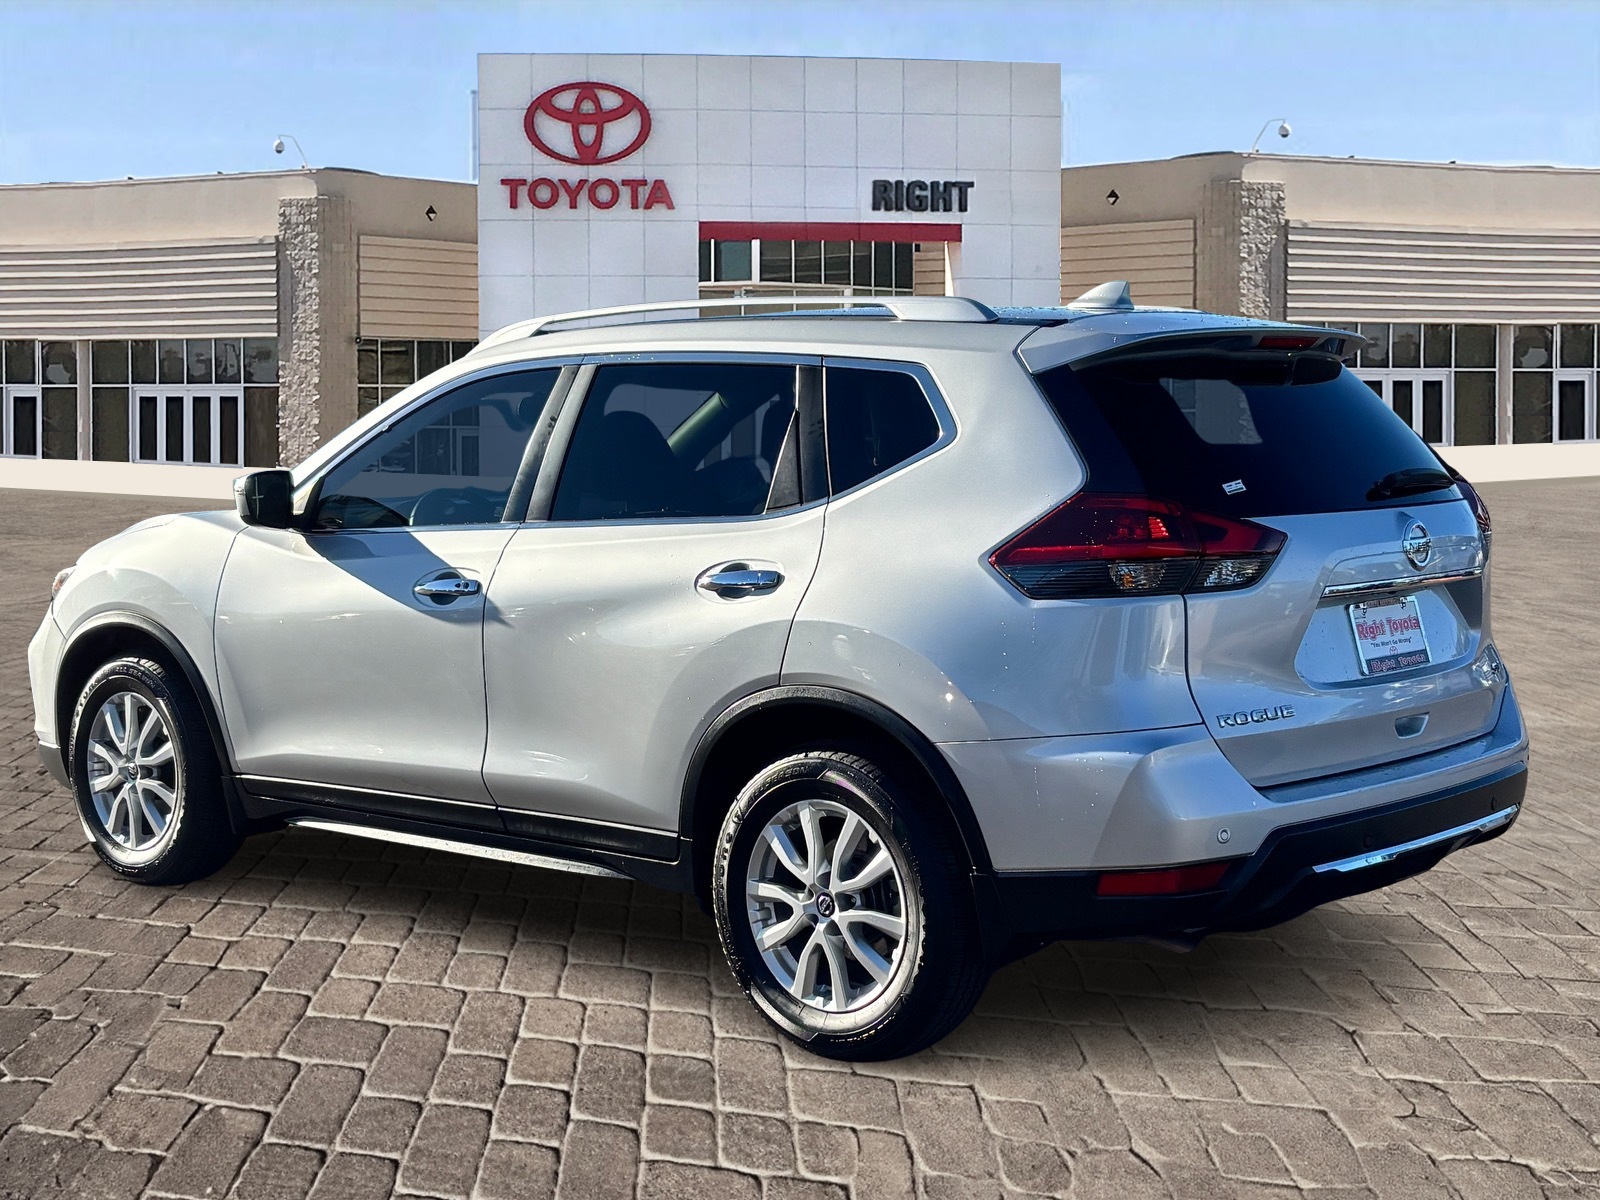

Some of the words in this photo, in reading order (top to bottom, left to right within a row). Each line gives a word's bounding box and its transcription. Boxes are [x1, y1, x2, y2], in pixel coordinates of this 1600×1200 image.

[500, 178, 675, 209] TOYOTA
[872, 179, 975, 212] RIGHT
[1355, 619, 1386, 641] Right
[1386, 614, 1421, 636] Toyota
[1216, 704, 1296, 728] ROGUE
